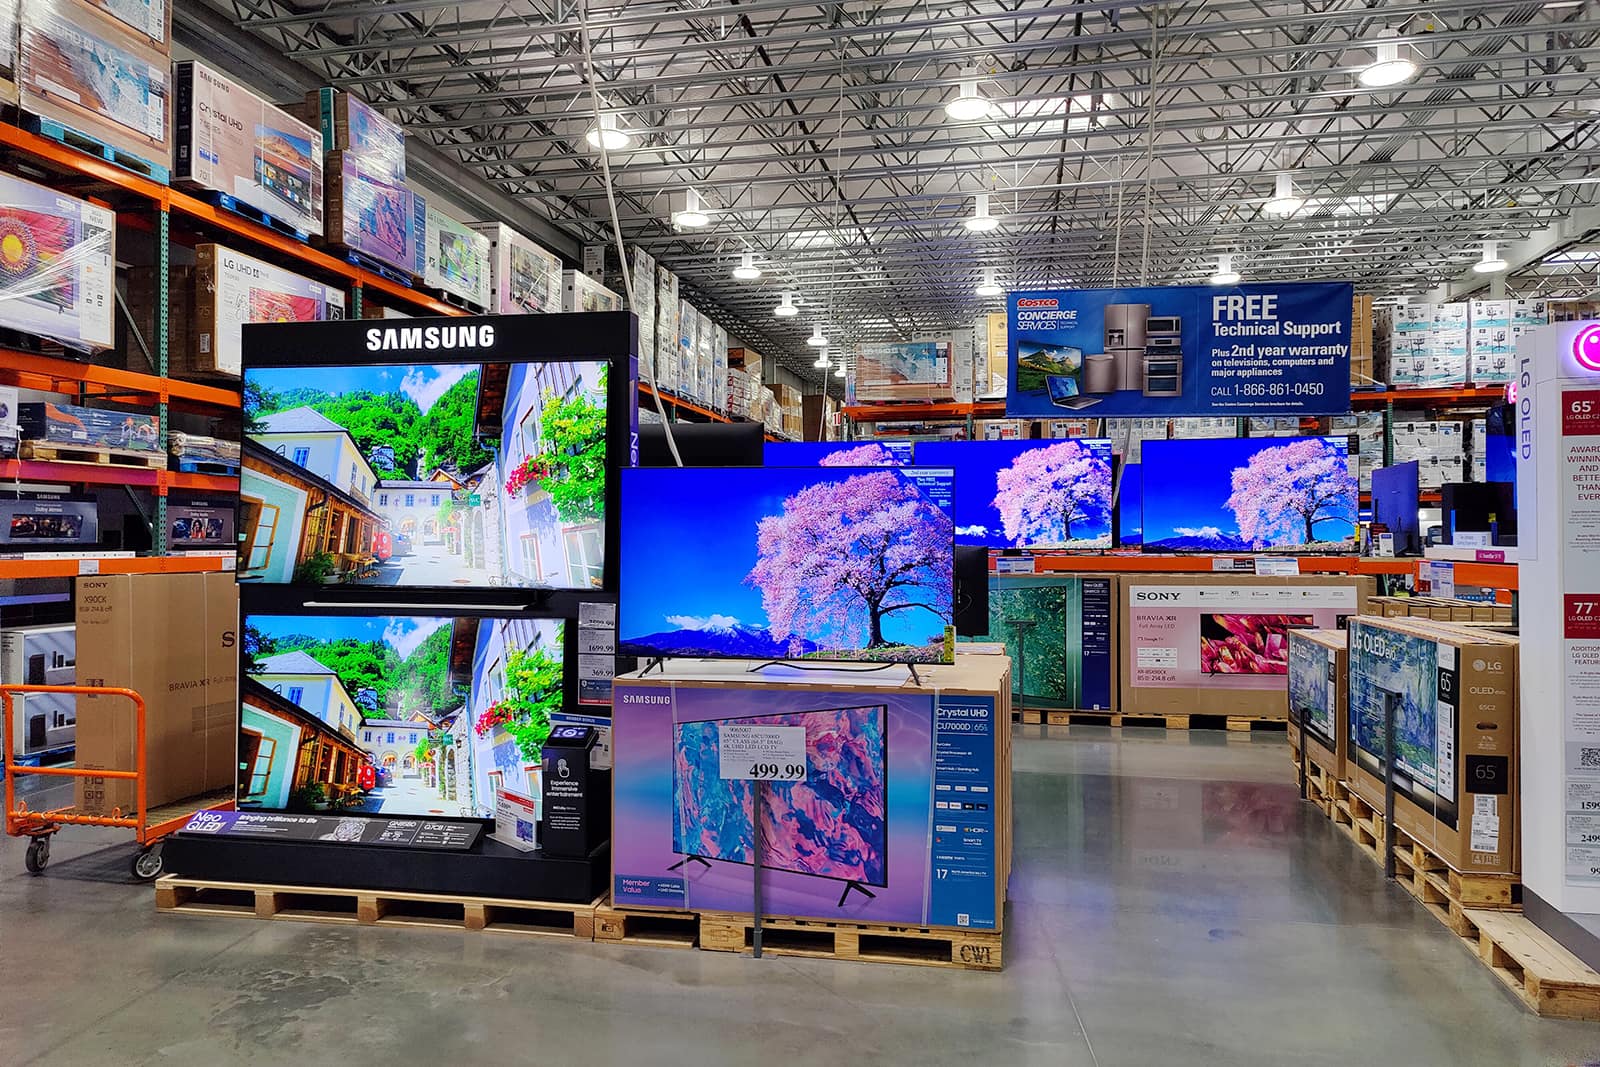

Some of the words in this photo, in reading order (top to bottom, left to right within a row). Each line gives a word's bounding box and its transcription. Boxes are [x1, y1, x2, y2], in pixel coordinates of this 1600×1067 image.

[228, 116, 243, 131] UHD
[224, 258, 234, 270] LG
[236, 262, 252, 276] UHD
[1212, 294, 1278, 320] FREE
[1018, 310, 1078, 320] CONCIERGE
[1016, 320, 1057, 330] SERVICES
[1212, 321, 1280, 336] Technical
[1283, 321, 1342, 338] Support
[366, 324, 494, 351] SAMSUNG
[1212, 348, 1230, 357] Plus
[1231, 344, 1254, 356] 2nd
[1257, 346, 1286, 359] year
[1288, 344, 1348, 358] warranty
[1224, 358, 1270, 367] televisions,
[1272, 358, 1316, 368] computers
[1318, 356, 1334, 365] and
[1212, 368, 1235, 378] major
[1236, 368, 1282, 378] appliances
[1521, 358, 1530, 388] LG
[1211, 386, 1232, 396] CALL
[1234, 382, 1324, 396] 1-866-861-0450
[1522, 398, 1531, 460] OLED
[1136, 592, 1180, 600] SONY
[588, 644, 614, 652] 1699.99
[1352, 630, 1362, 650] LG
[1364, 633, 1385, 657] OLED
[1386, 648, 1396, 660] evo
[1488, 662, 1502, 671] LG
[591, 669, 614, 678] 369.99
[168, 680, 198, 692] BRAVIA
[199, 678, 210, 687] XR
[1440, 672, 1452, 692] 65
[1470, 686, 1494, 695] OLED
[623, 694, 670, 705] SAMSUNG
[936, 708, 968, 718] Crystal
[970, 709, 988, 717] UHD
[936, 722, 970, 730] CU7000D
[750, 763, 804, 779] 499.99
[1476, 764, 1496, 780] 65
[193, 812, 222, 822] Neo
[239, 814, 266, 823] Bringing
[186, 820, 226, 832] QLED
[936, 869, 948, 879] 17
